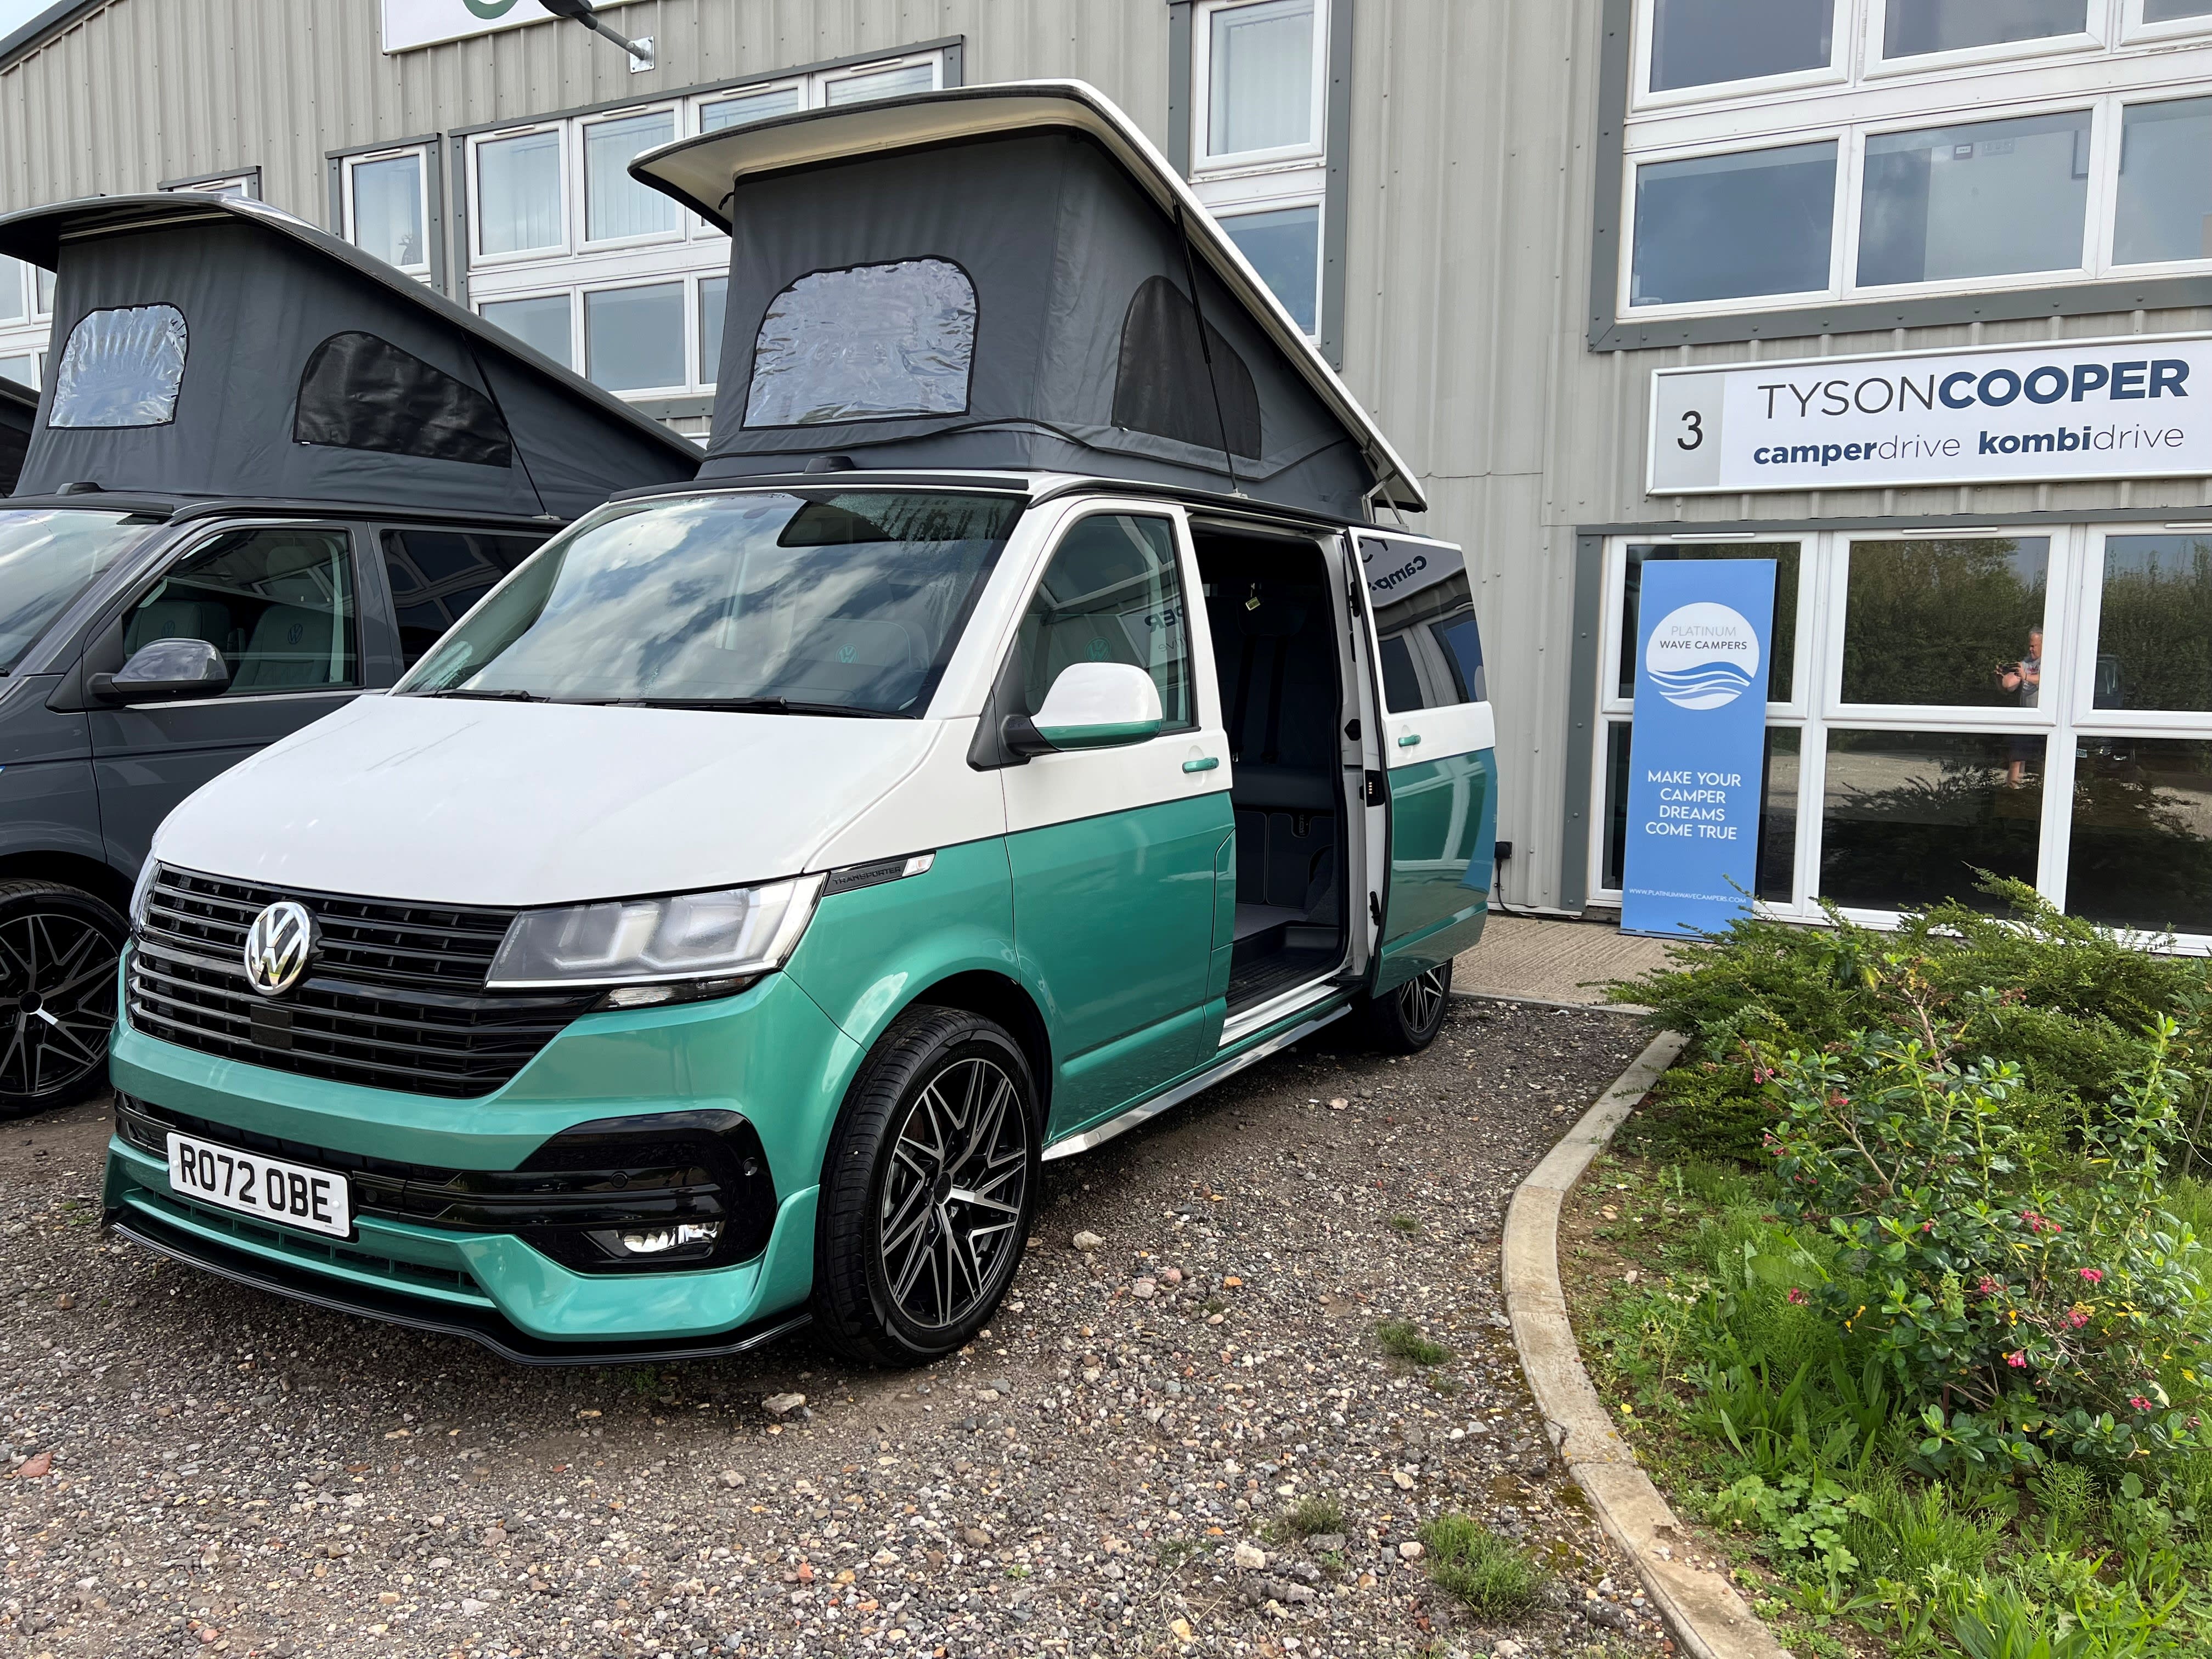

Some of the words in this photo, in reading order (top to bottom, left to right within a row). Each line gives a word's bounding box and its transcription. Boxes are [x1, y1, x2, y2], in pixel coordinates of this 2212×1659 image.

[1757, 359, 2190, 420] TYSONCOOPER
[1677, 410, 1703, 450] 3
[1753, 435, 1961, 466] camperdrive
[1978, 424, 2185, 455] kombidrive
[1671, 626, 1736, 636] PLATINUM
[1660, 640, 1691, 649] WAVE
[1695, 641, 1747, 650] CAMPERS
[1647, 770, 1692, 784] MAKE
[1697, 772, 1742, 787] YOUR
[1660, 788, 1726, 804] CAMPER
[1659, 805, 1725, 821] DREAMS
[1645, 822, 1693, 837] COME
[1698, 825, 1737, 840] TRUE
[832, 866, 901, 885] TRANSPORTER
[1629, 888, 1747, 904] WWW.PLATINUMWAVECAMPERS.COM
[179, 1143, 257, 1205] RO72
[266, 1167, 332, 1224] OBE
